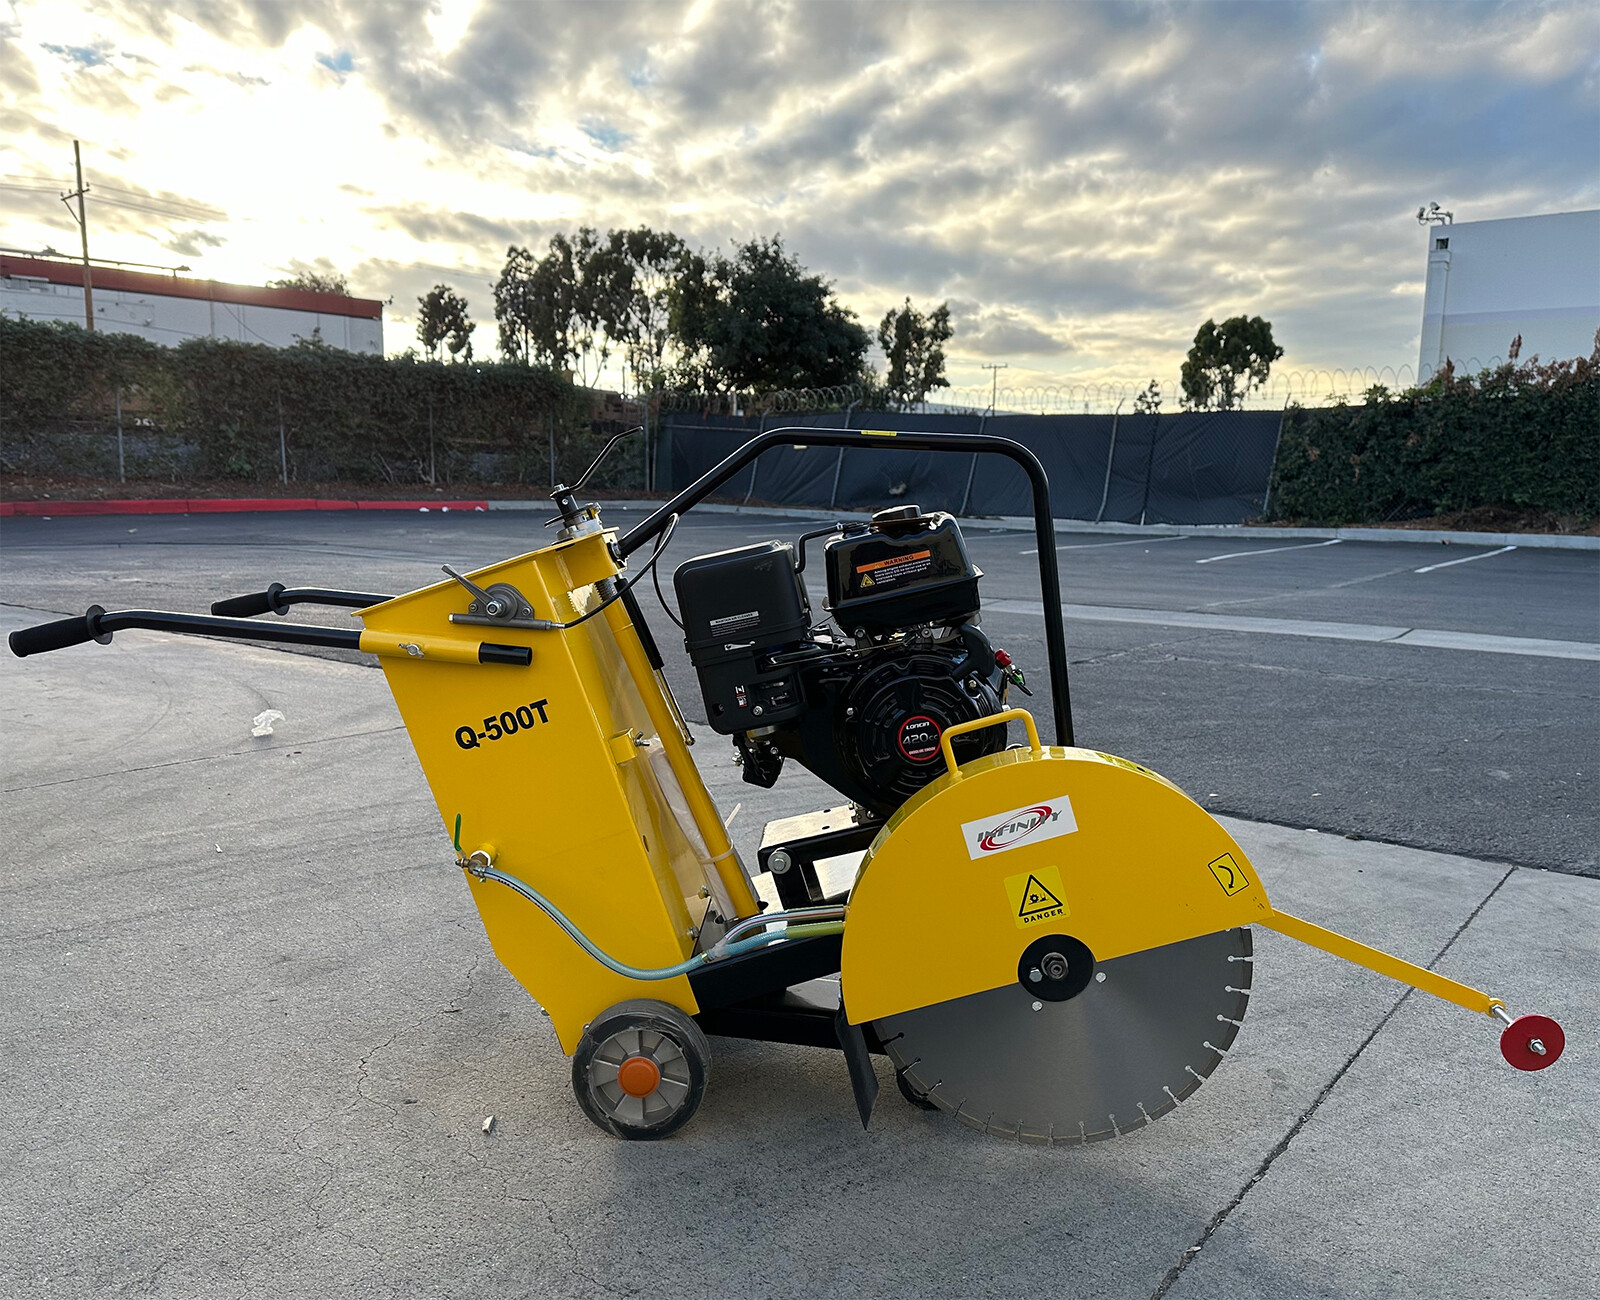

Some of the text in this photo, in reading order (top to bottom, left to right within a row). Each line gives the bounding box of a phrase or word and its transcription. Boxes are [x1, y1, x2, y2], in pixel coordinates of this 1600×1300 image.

[884, 555, 914, 566] WARNING
[455, 698, 549, 750] Q-500T
[902, 732, 939, 745] 420cc
[977, 809, 1063, 843] INFINITY
[1023, 908, 1064, 924] DANGER
